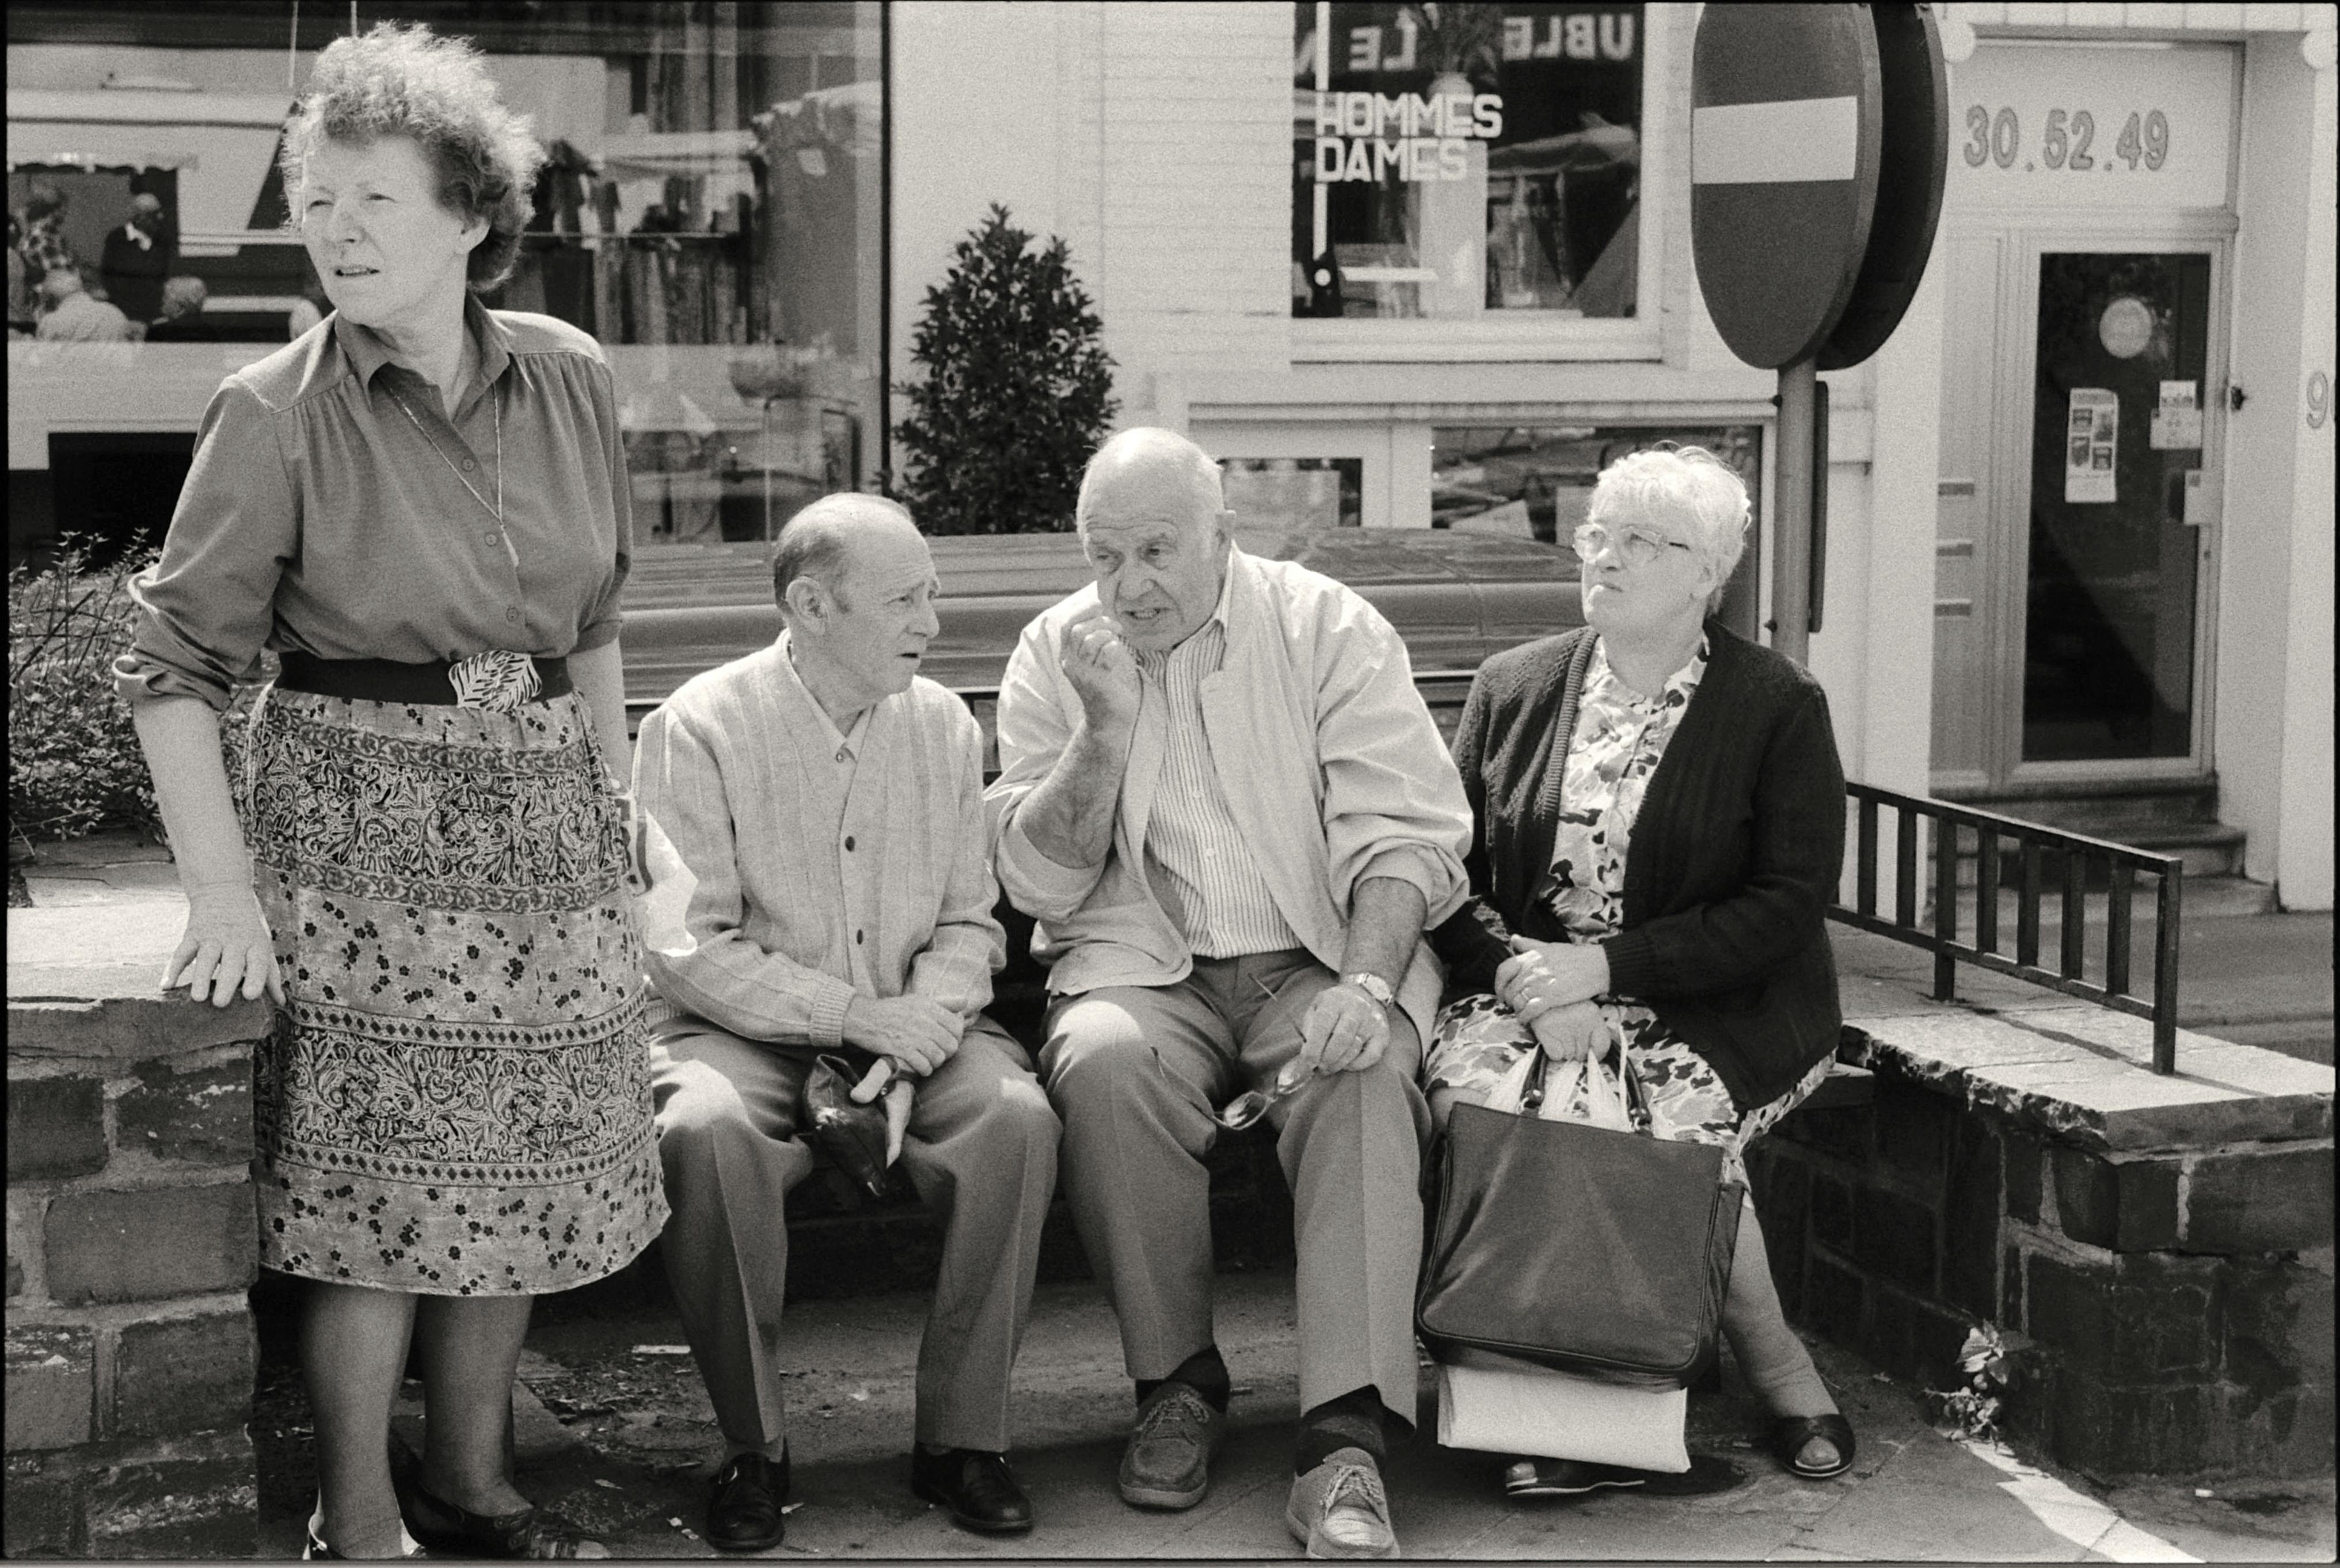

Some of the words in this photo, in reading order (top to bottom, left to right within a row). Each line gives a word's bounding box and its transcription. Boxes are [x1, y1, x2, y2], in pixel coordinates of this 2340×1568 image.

[1315, 91, 1503, 138] HOMMES
[1963, 104, 2169, 172] 30.52.49
[1315, 138, 1468, 182] DAMES
